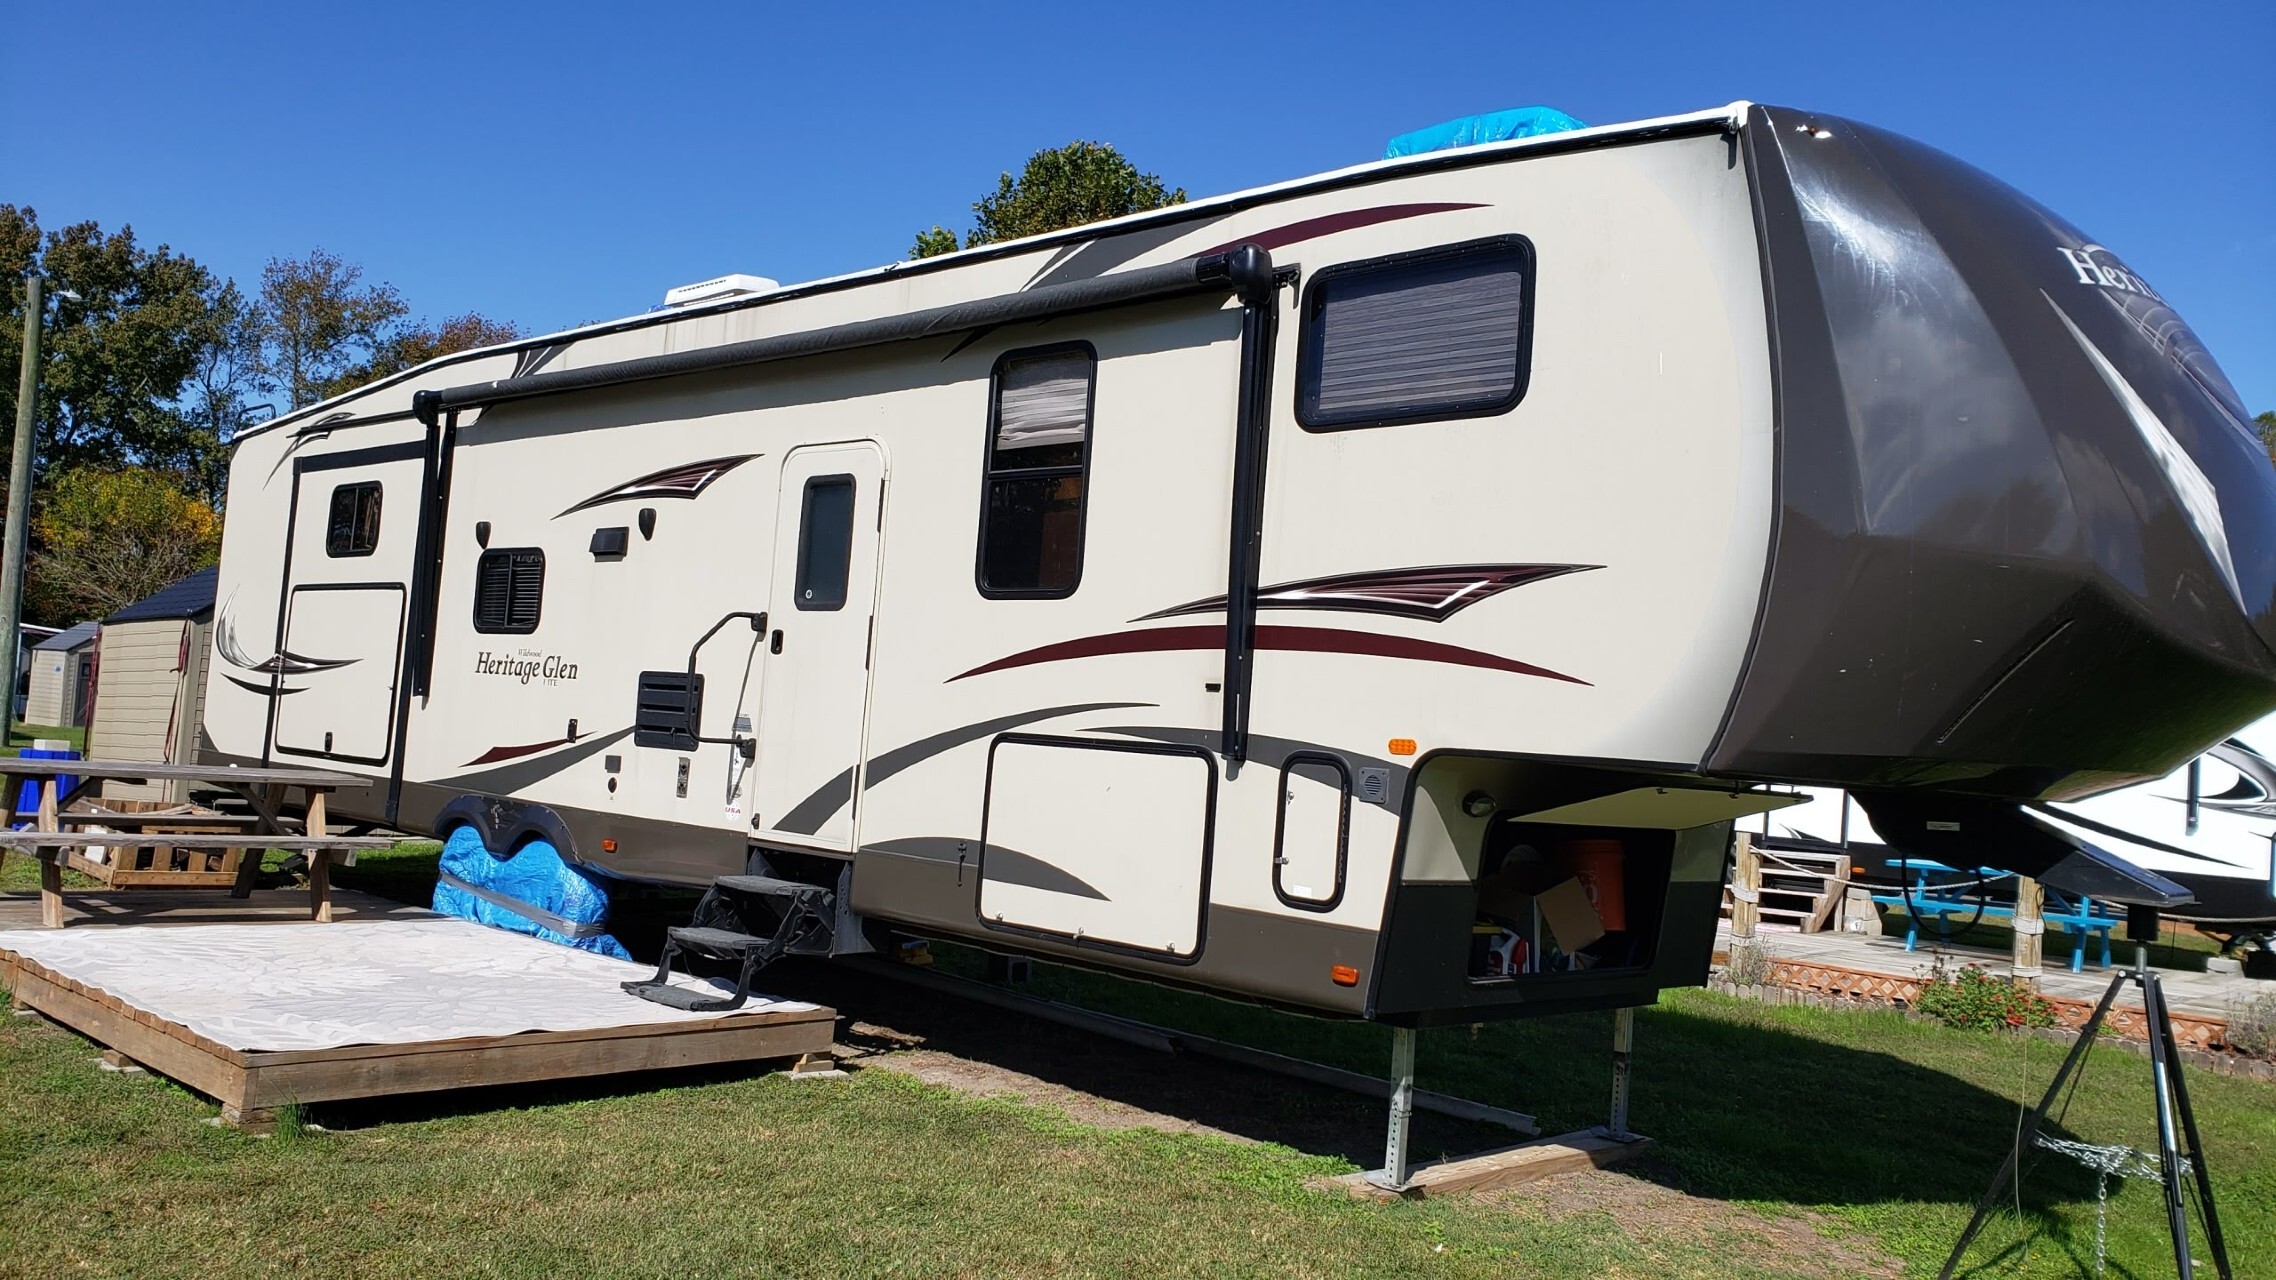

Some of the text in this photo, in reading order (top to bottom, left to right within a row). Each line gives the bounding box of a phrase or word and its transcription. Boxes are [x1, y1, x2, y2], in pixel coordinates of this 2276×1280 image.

[2057, 247, 2169, 306] Herit
[475, 652, 578, 685] Heritage Glen
